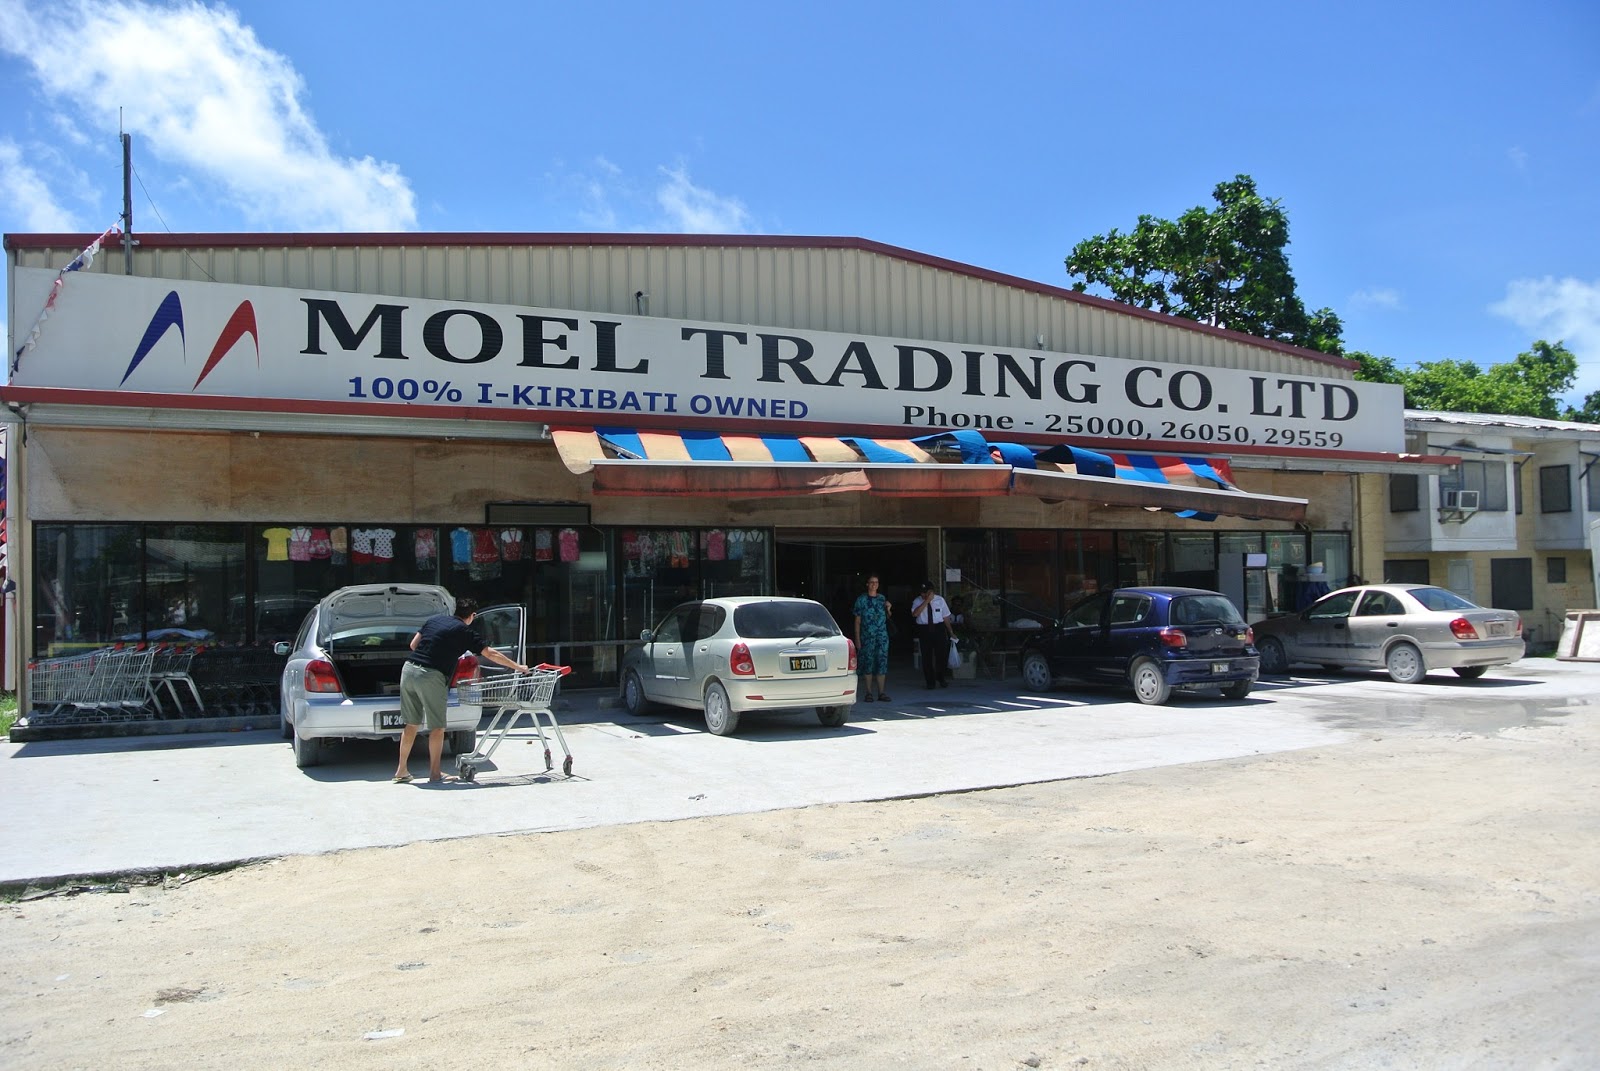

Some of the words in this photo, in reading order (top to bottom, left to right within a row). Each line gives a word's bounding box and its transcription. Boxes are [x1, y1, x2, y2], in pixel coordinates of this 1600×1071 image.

[299, 297, 650, 375] MOEL
[680, 327, 1102, 405] TRADING
[1124, 366, 1228, 413] CO.
[1249, 376, 1359, 422] LTD
[348, 376, 463, 403] 100%
[477, 382, 678, 413] I-KIRIBATI
[689, 394, 809, 419] OWNED
[902, 405, 1014, 431] Phone
[1044, 413, 1152, 440] 25000,
[1160, 420, 1257, 446] 26050,
[1264, 427, 1344, 448] 29559
